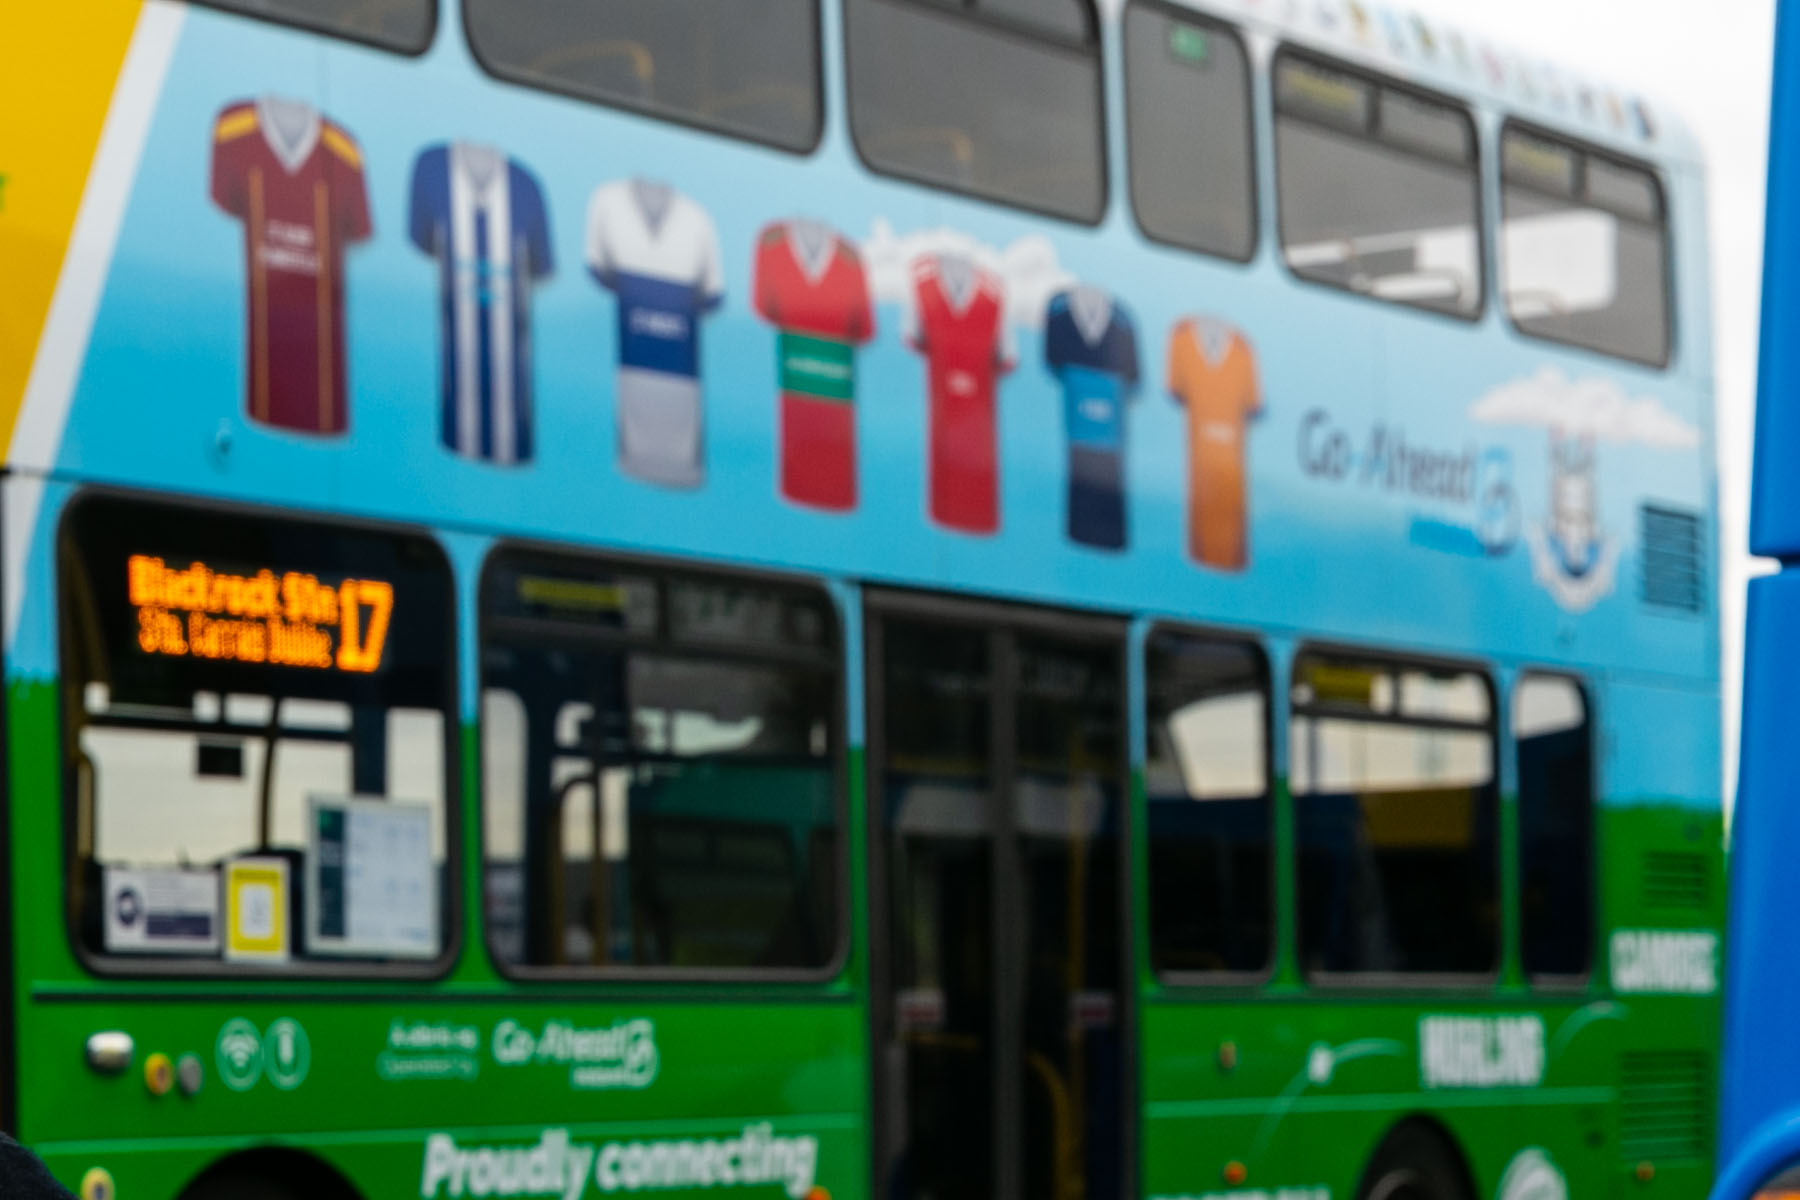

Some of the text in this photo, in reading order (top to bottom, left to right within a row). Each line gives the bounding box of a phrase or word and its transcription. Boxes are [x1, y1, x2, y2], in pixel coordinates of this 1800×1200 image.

[1296, 406, 1476, 506] Go-Ahead
[336, 578, 394, 673] 17
[492, 1018, 627, 1065] Go-Ahead
[596, 1123, 819, 1199] connecting
